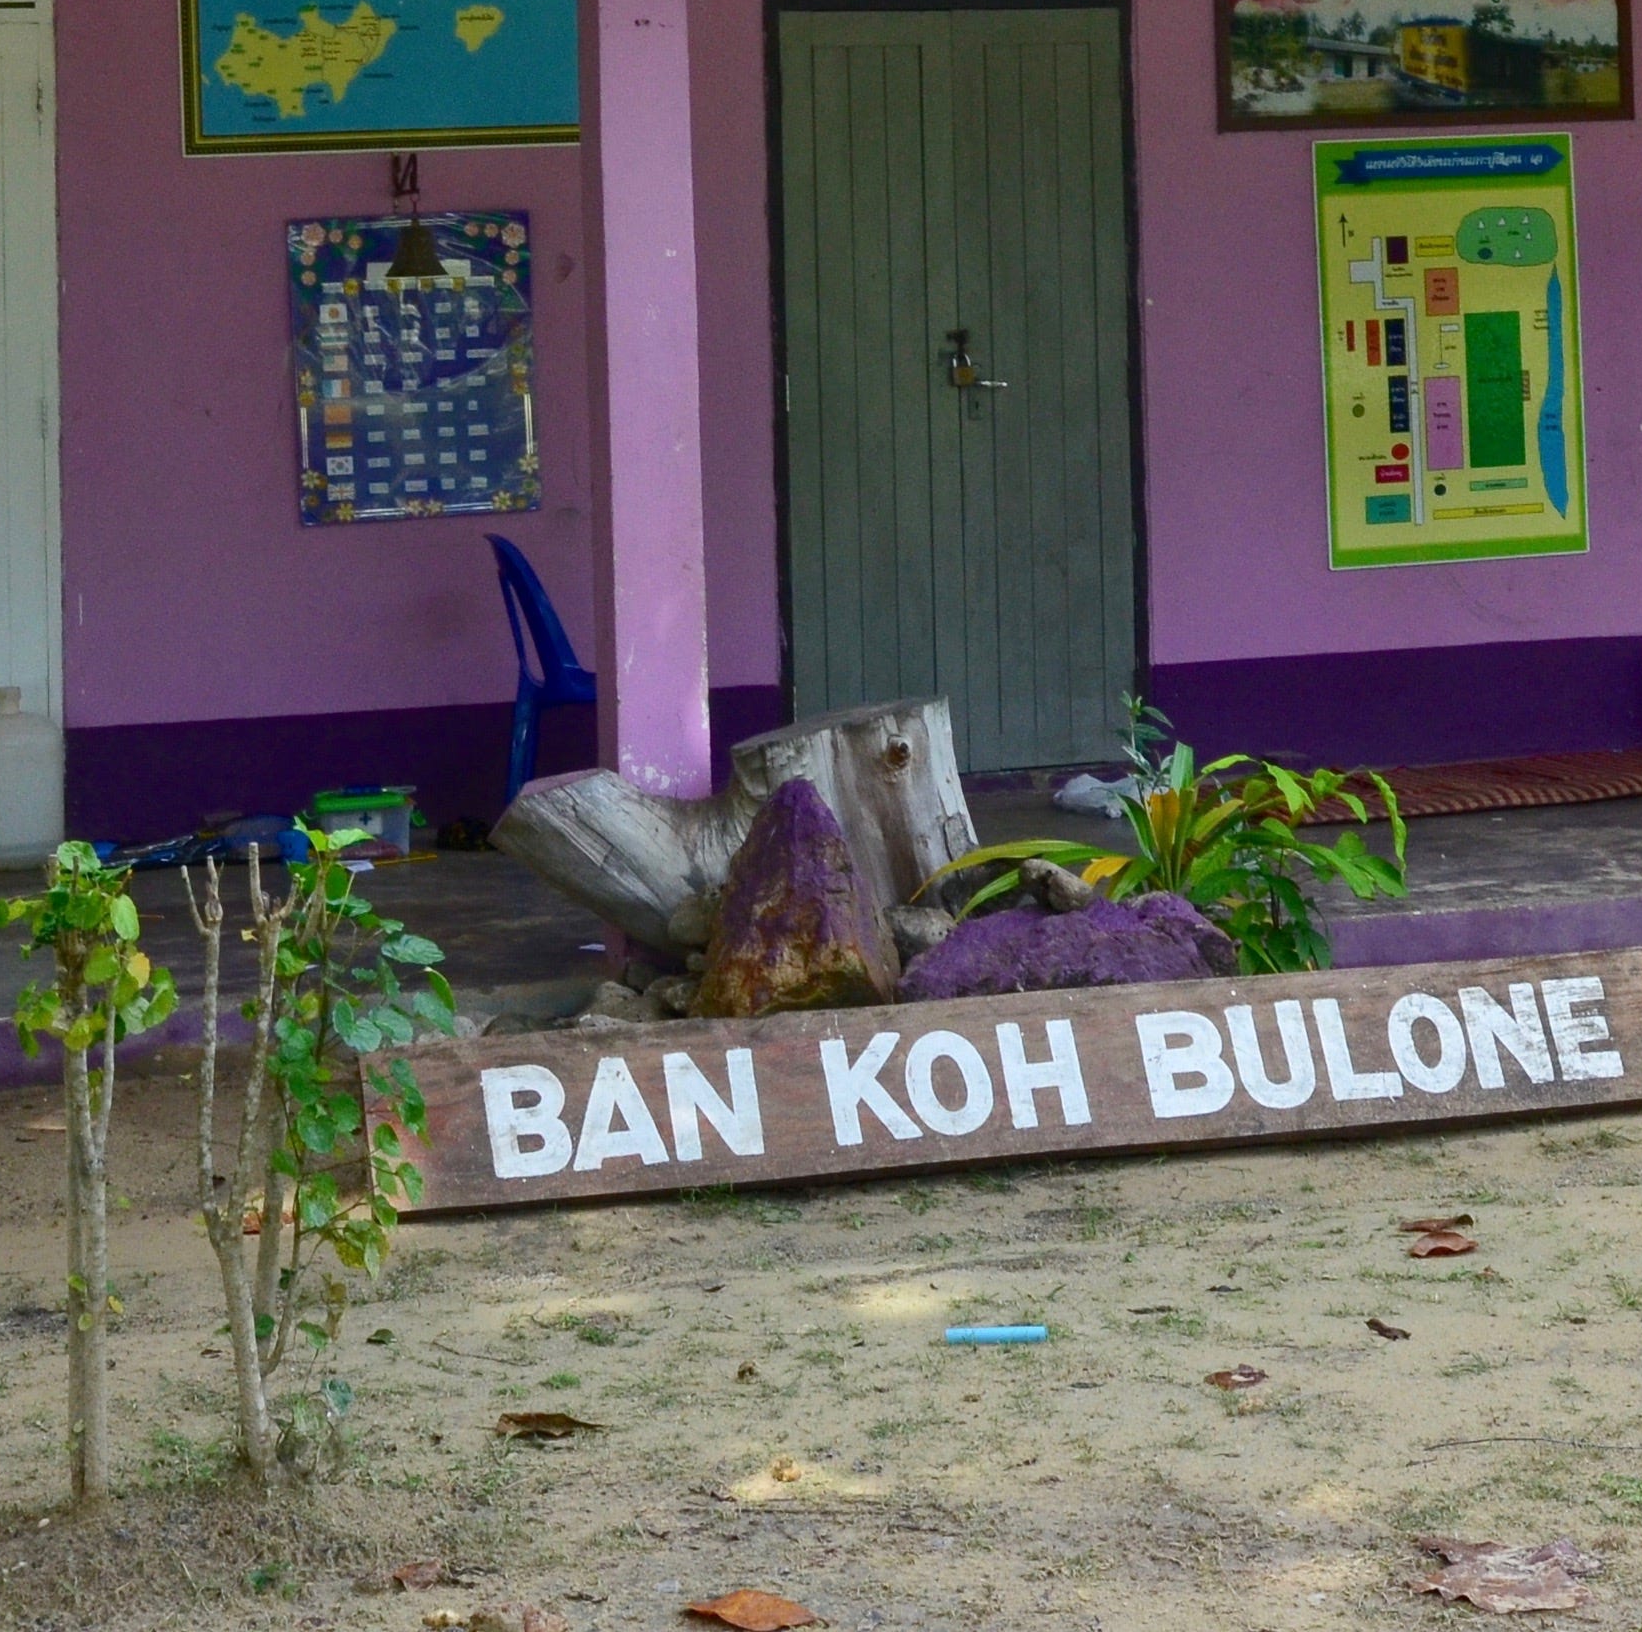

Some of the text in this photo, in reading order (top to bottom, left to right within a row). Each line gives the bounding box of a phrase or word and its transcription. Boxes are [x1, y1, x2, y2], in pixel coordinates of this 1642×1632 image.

[478, 974, 1625, 1180] BAN KOH BULONE
